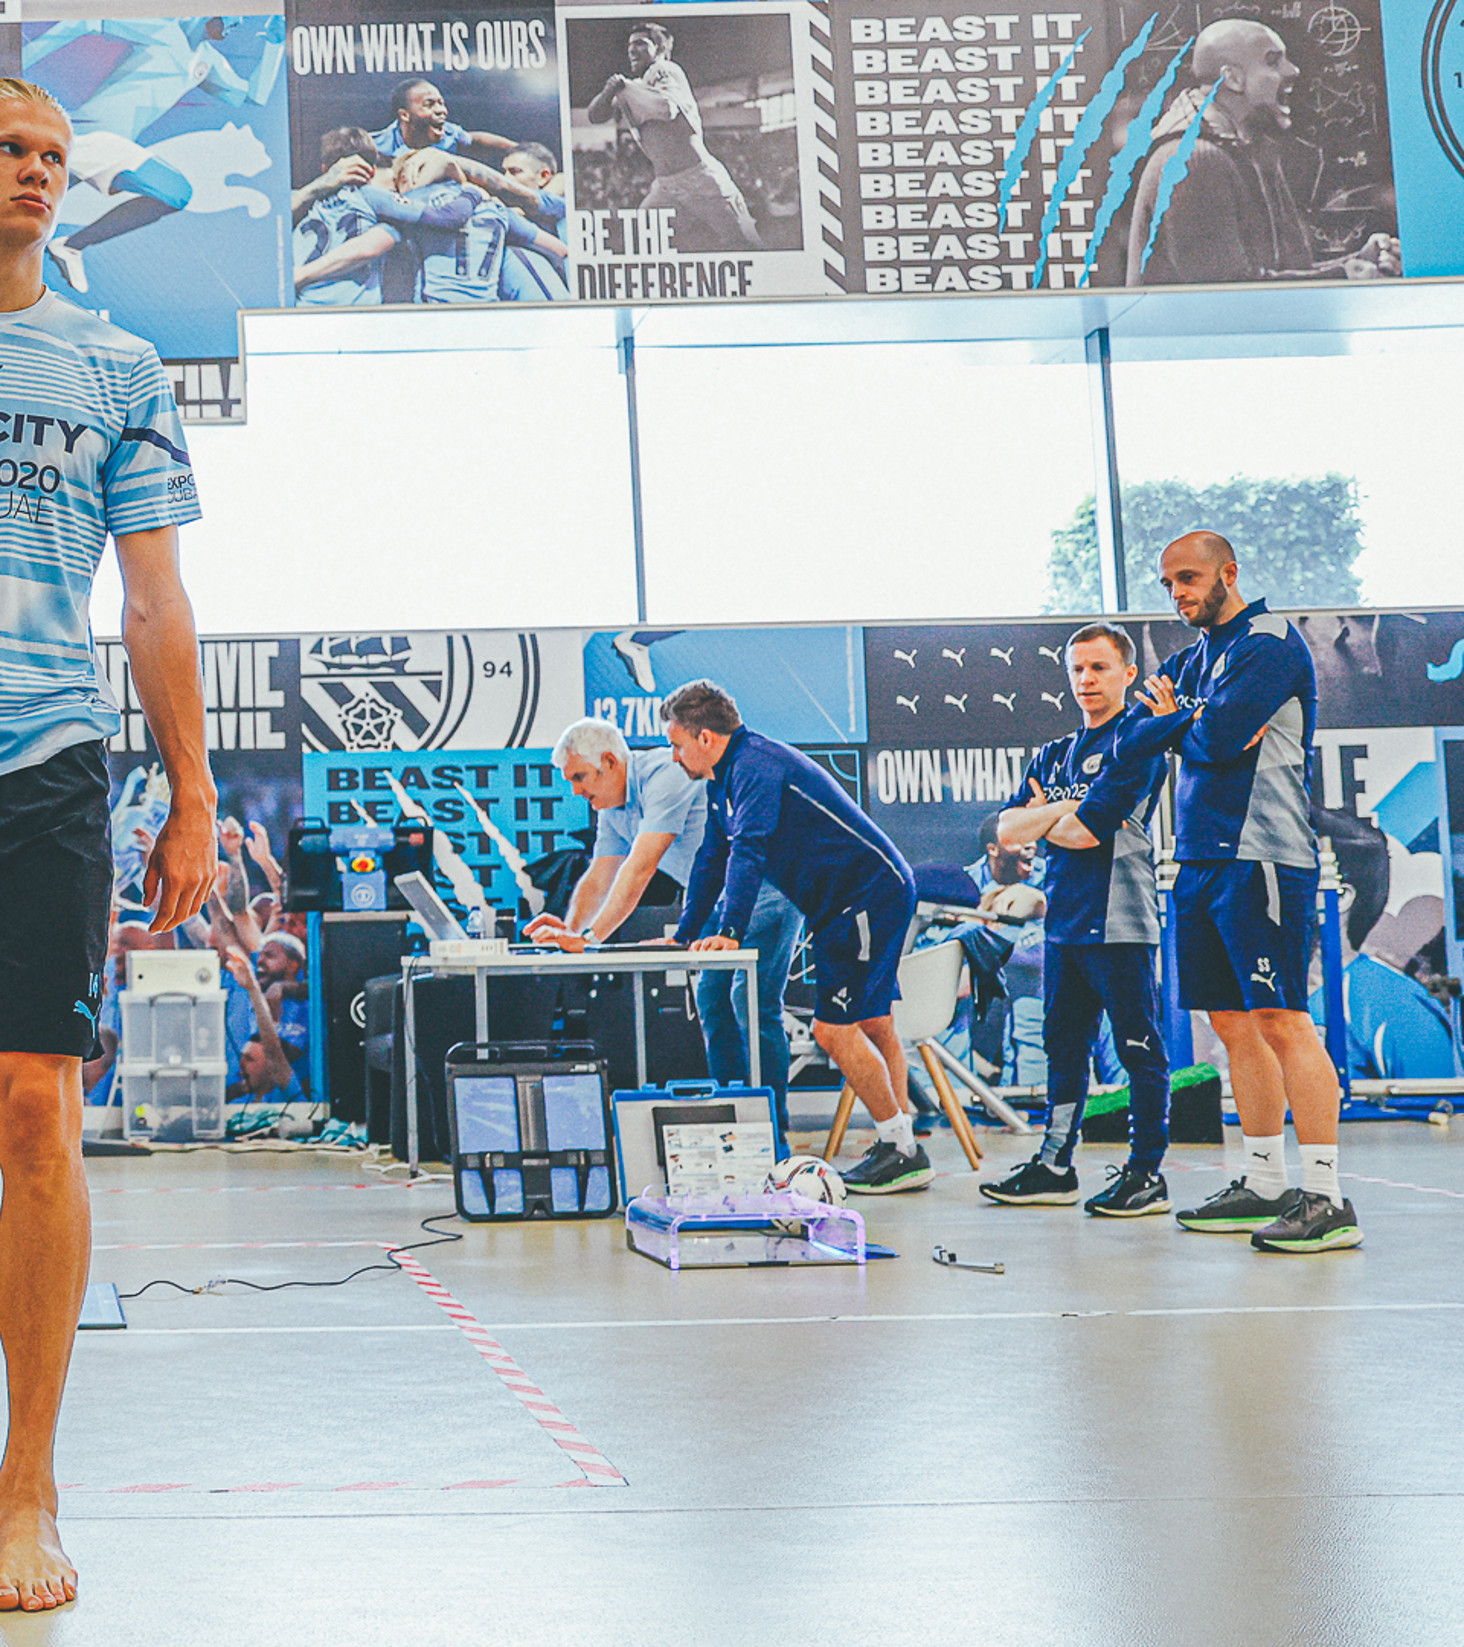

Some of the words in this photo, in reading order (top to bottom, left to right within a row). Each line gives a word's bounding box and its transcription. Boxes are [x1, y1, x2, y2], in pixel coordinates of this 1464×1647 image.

[850, 14, 1020, 44] BEAST
[1031, 13, 1082, 39] IT
[291, 24, 357, 77] OWN
[359, 21, 436, 74] WHAT
[441, 20, 471, 72] IS
[474, 18, 547, 71] OURS
[852, 45, 1022, 74] BEAST
[1034, 44, 1084, 71] IT
[854, 75, 1024, 105] BEAST
[856, 107, 1025, 137] BEAST
[1039, 138, 1075, 164] I
[861, 200, 1032, 230] BEAST
[574, 208, 613, 255] BE
[617, 207, 678, 255] THE
[863, 232, 1033, 261] BEAST
[1046, 231, 1094, 258] IT
[454, 217, 503, 278] 17
[576, 260, 753, 300] DIFFERENCE
[865, 263, 1035, 292] BEAST
[1048, 263, 1098, 289] IT
[482, 660, 514, 679] 94
[326, 764, 499, 792] BEAST
[513, 764, 557, 789] IT
[876, 749, 943, 805] OWN
[946, 746, 1026, 803] WHAT
[515, 797, 564, 820] IT
[516, 829, 565, 855] IT
